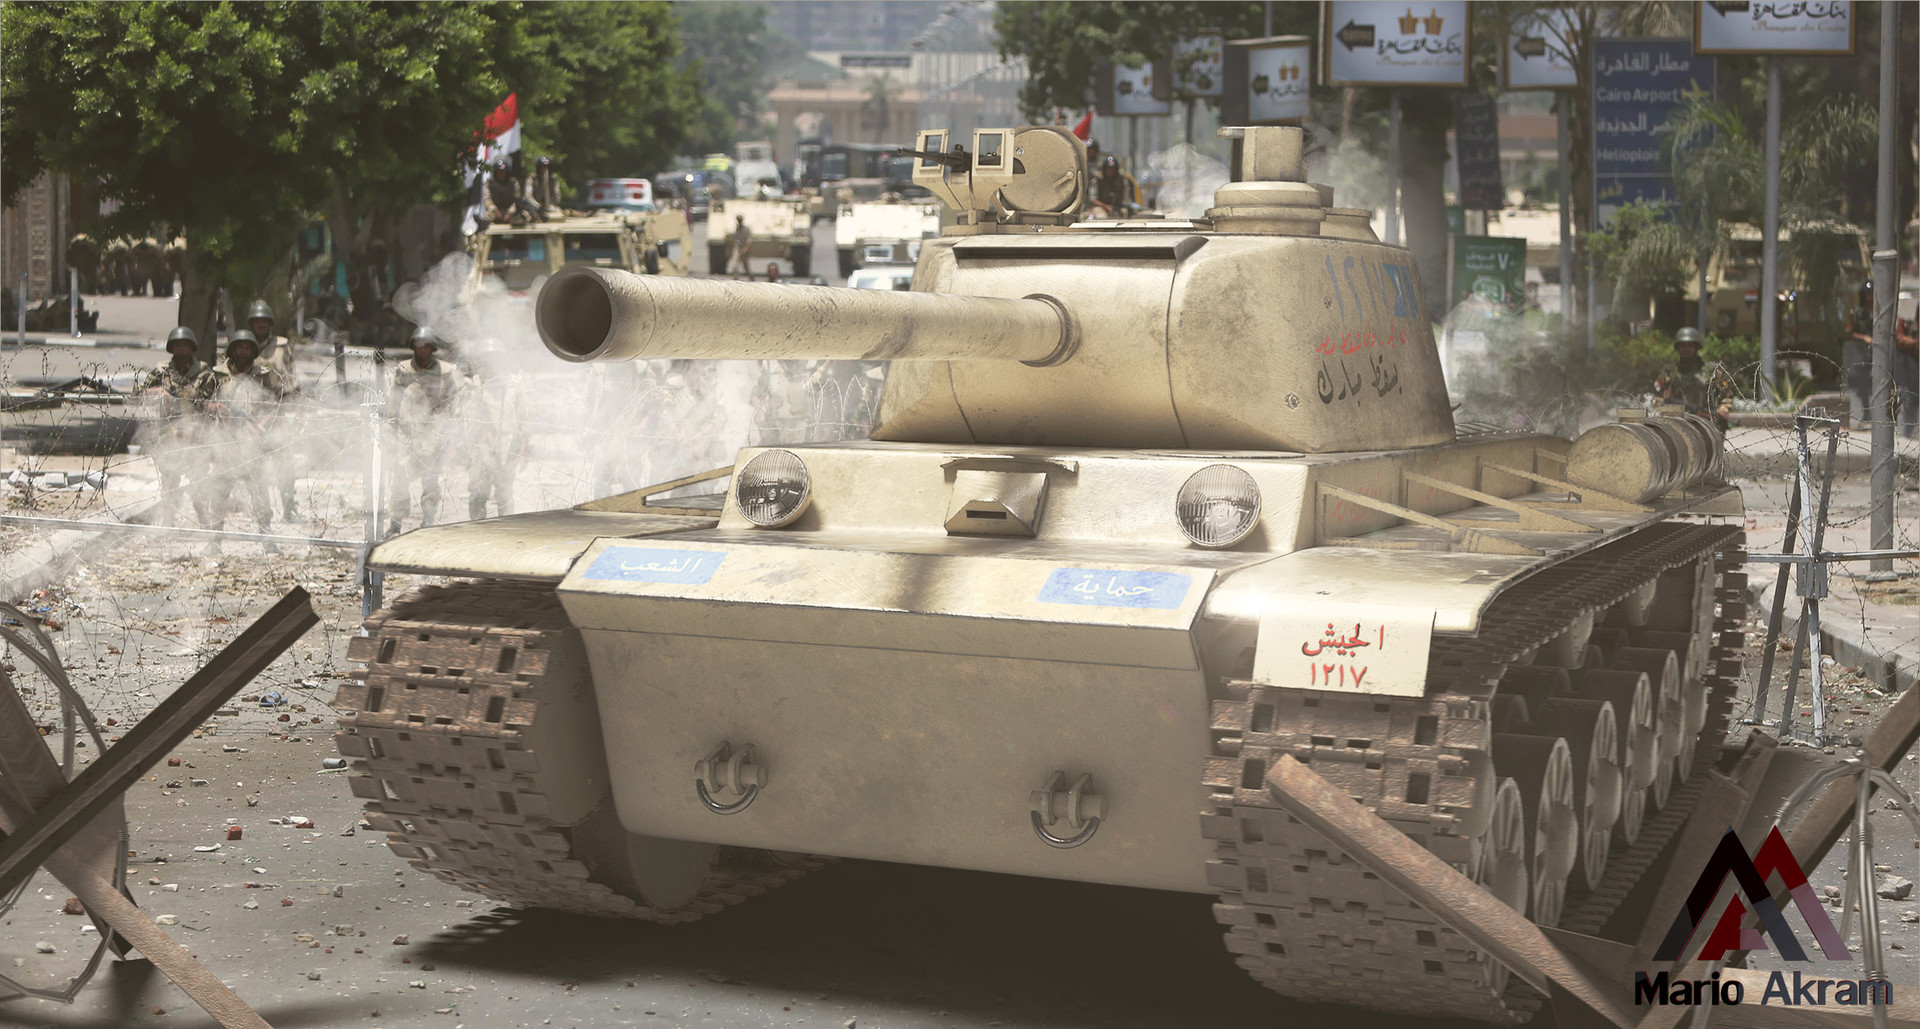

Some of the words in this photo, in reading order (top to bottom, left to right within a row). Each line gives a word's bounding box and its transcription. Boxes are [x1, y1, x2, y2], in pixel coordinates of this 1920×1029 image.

[1596, 52, 1650, 76] القاهرة
[1650, 52, 1689, 76] مطار
[1596, 87, 1631, 102] Cairo
[1633, 87, 1680, 103] Airport
[1648, 120, 1676, 136] صر
[620, 557, 704, 576] الشعب
[1073, 574, 1154, 601] حماية
[1302, 622, 1384, 657] الجيش
[1311, 661, 1367, 689] ١٢١٧
